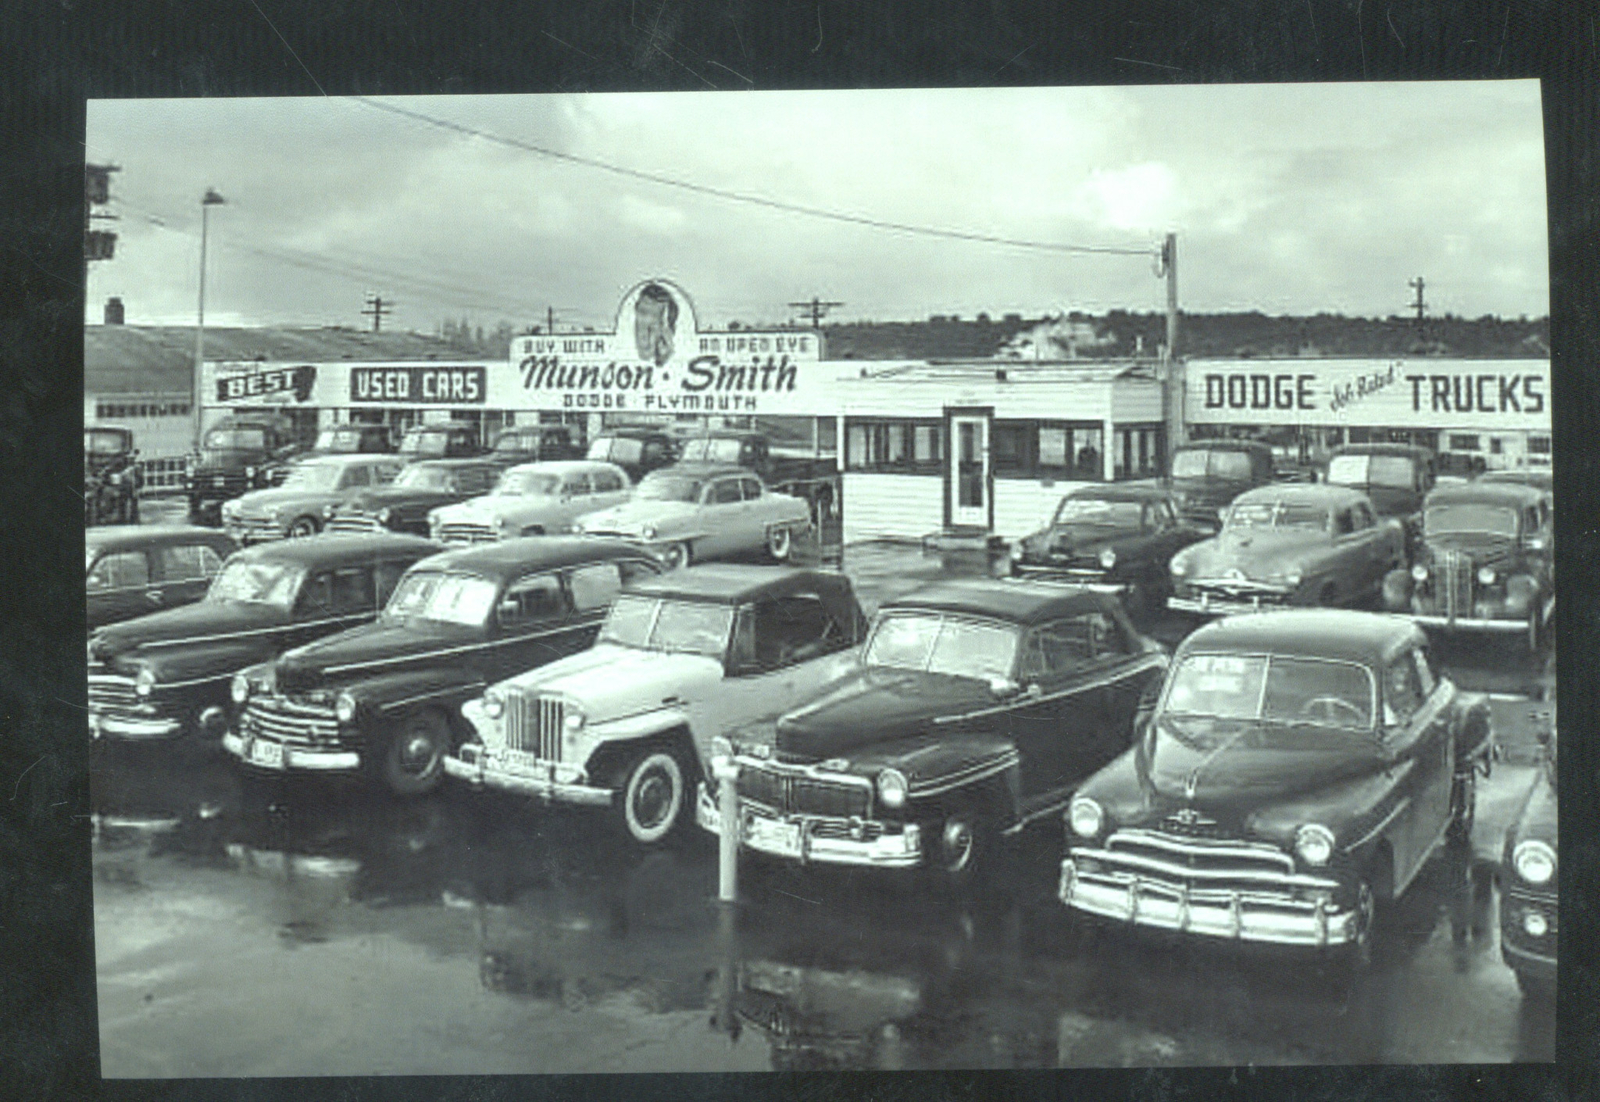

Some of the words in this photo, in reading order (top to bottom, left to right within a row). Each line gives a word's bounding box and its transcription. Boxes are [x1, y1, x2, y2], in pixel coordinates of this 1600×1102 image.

[524, 339, 555, 354] BUY
[563, 339, 605, 354] WITH
[226, 370, 297, 398] BEST
[357, 371, 409, 398] USED
[422, 371, 479, 399] CARS
[519, 354, 654, 390] Munson
[681, 355, 798, 391] Smith
[563, 393, 626, 408] DODGE
[644, 394, 757, 410] PLYMOUTH
[1204, 374, 1318, 410] DODGE
[1405, 375, 1544, 413] TRUCKS
